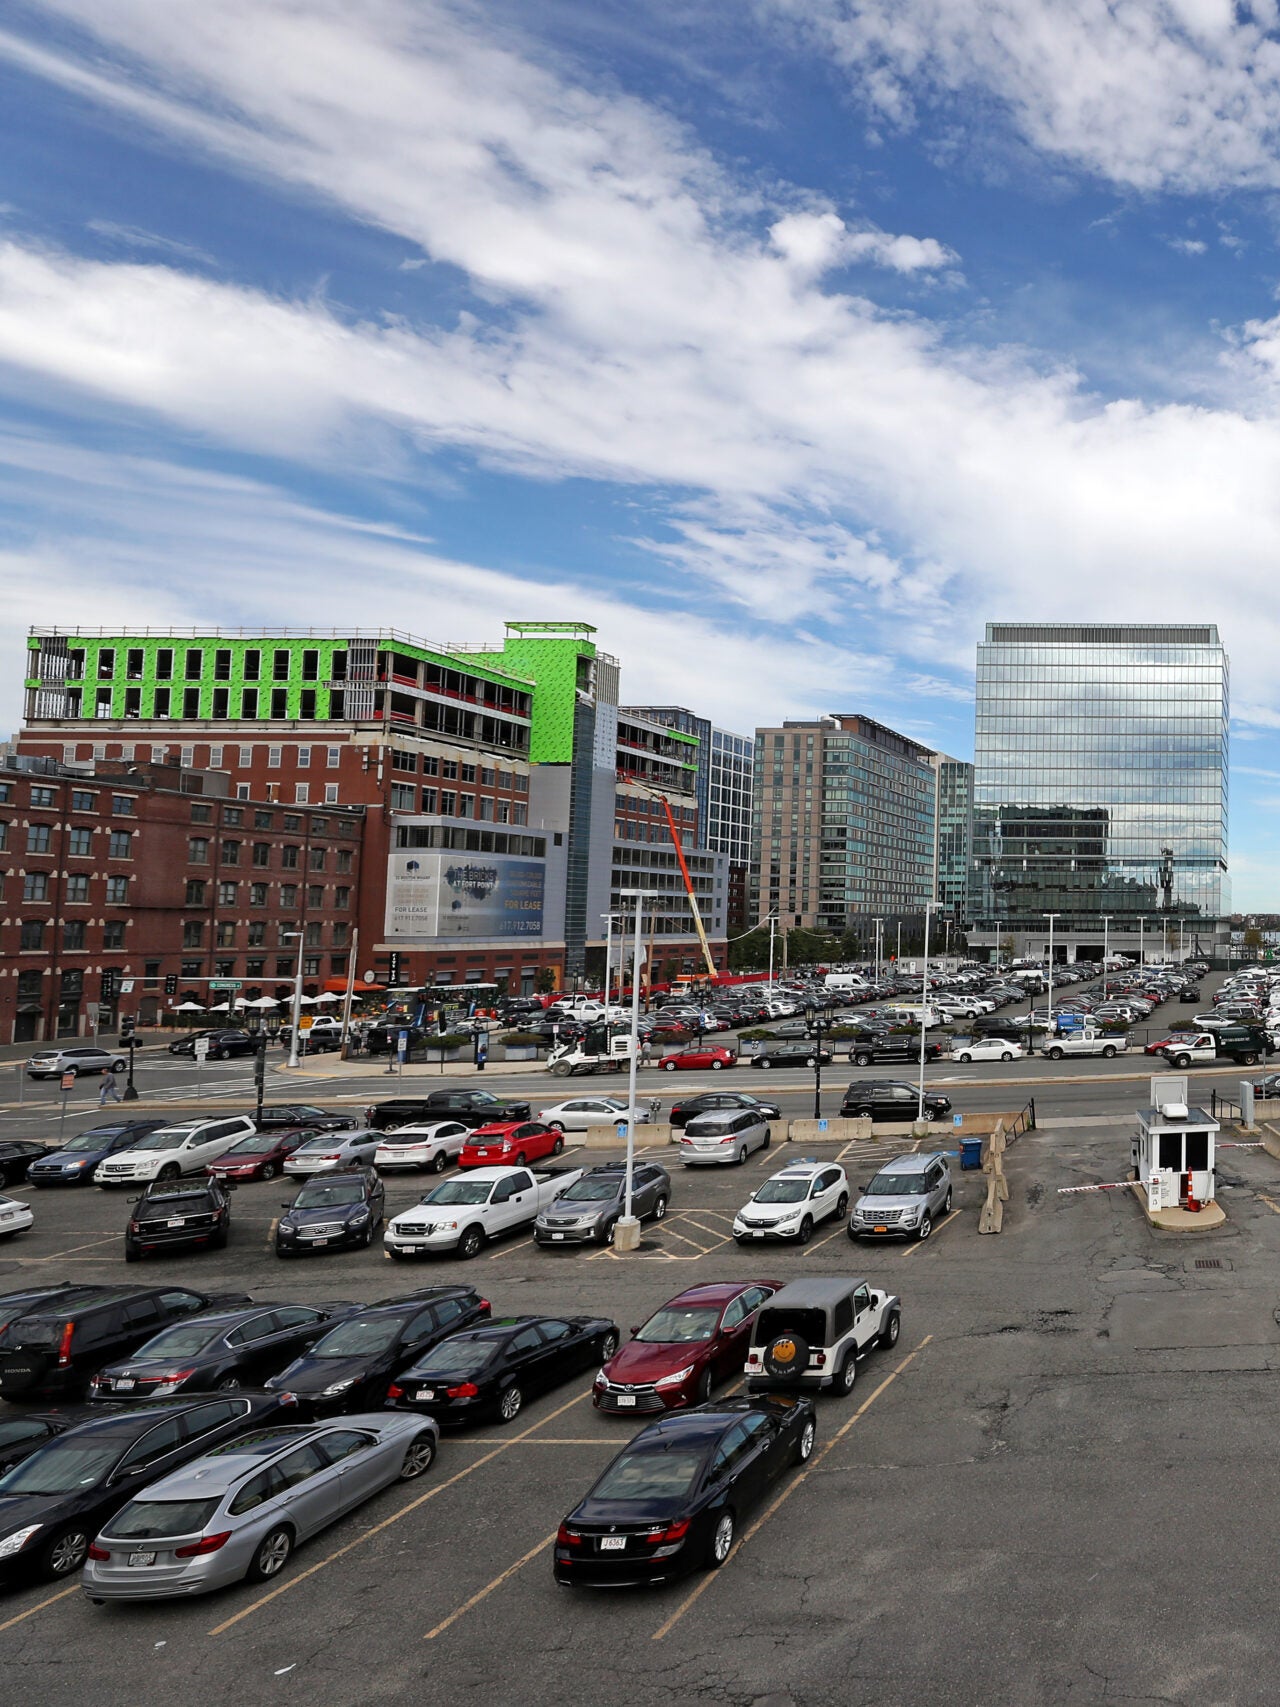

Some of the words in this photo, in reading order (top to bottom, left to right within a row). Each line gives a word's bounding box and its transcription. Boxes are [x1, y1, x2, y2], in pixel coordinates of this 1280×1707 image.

[469, 871, 494, 881] BRICKS
[476, 881, 493, 889] POINT
[504, 900, 519, 910] FOR
[520, 901, 542, 911] LEASE
